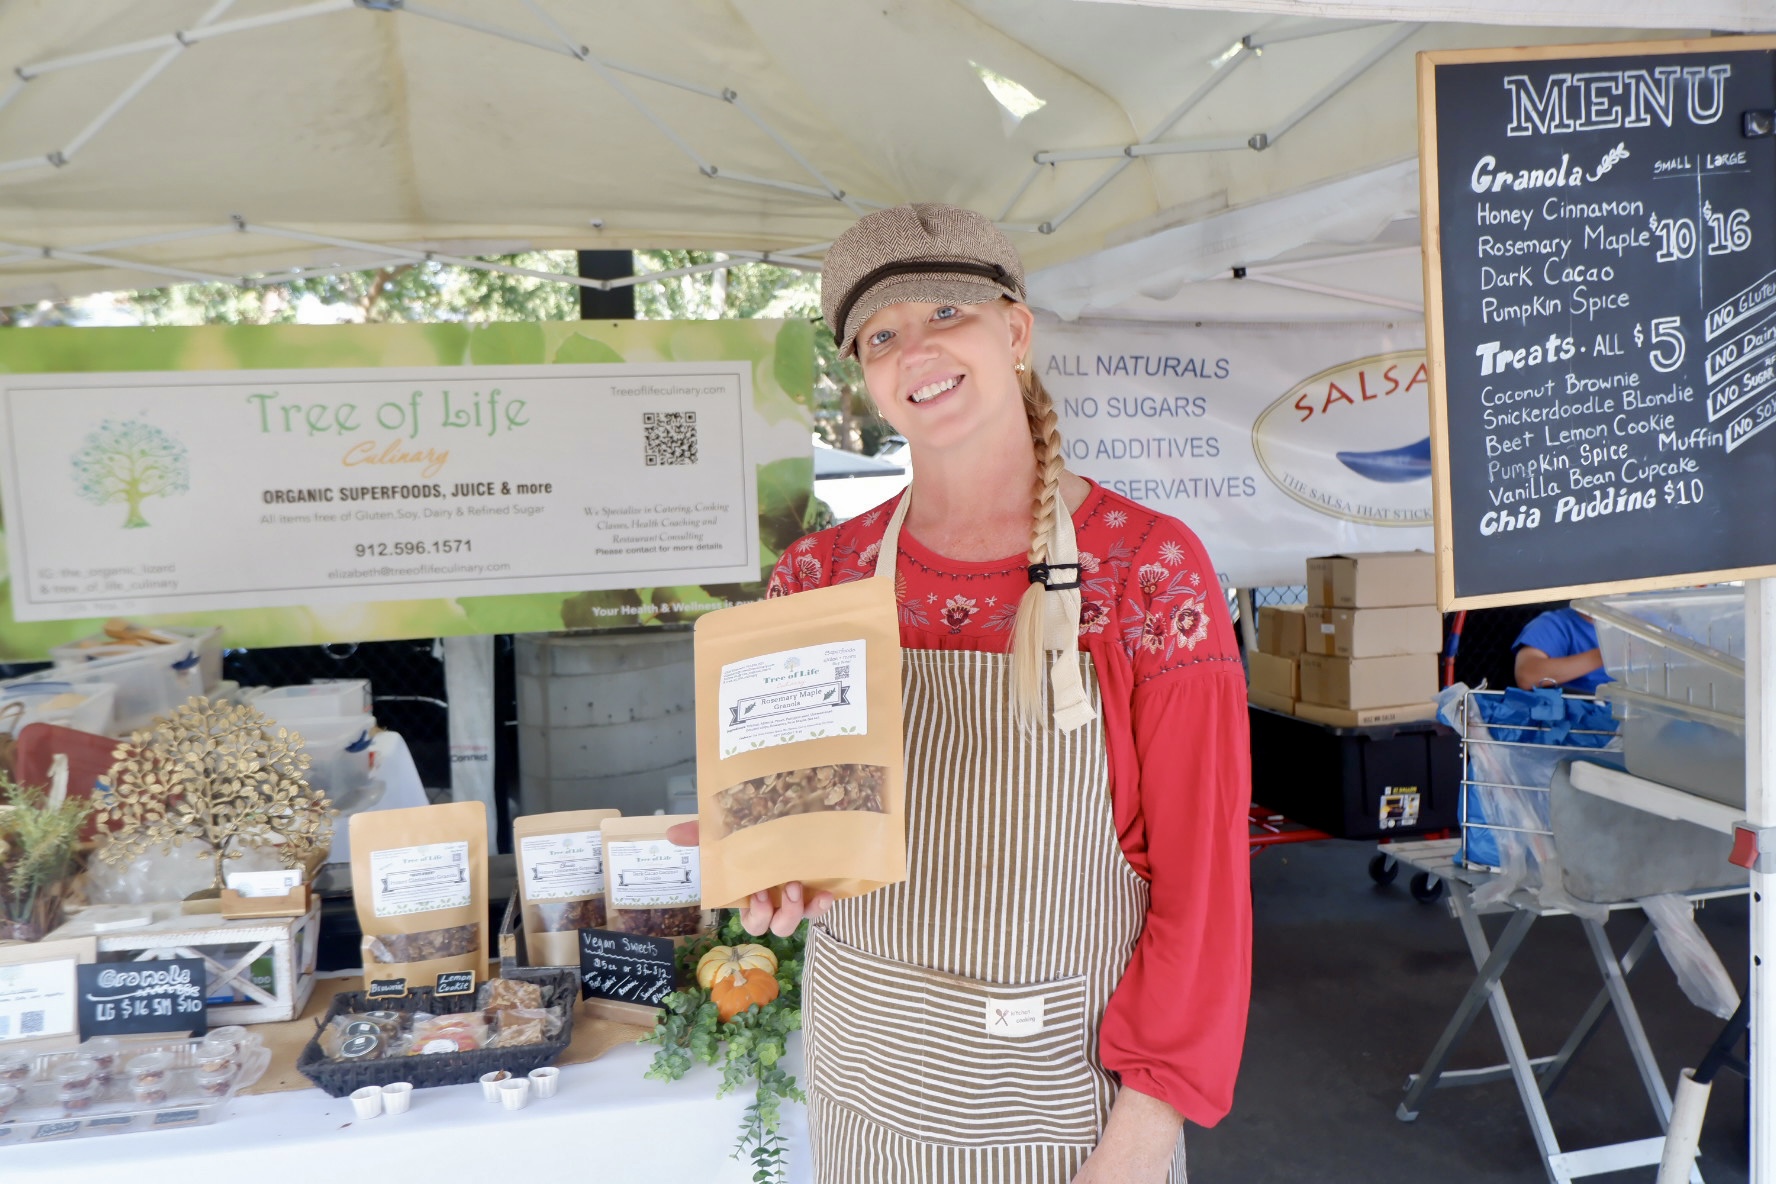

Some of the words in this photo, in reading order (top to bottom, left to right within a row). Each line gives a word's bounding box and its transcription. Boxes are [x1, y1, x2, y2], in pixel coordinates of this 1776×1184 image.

[1504, 64, 1731, 136] MENU
[1471, 154, 1582, 193] Granola
[1653, 154, 1692, 174] SMALL
[1477, 201, 1533, 230] Honey
[1542, 197, 1644, 221] Cinnamon
[1649, 212, 1696, 263] $10
[1703, 199, 1752, 255] $16
[1478, 234, 1571, 259] Rosemary
[1584, 225, 1650, 257] Maple
[1481, 266, 1533, 290] Dark
[1543, 257, 1614, 284] Cacao
[1482, 296, 1561, 325] Pumpkin
[1570, 285, 1630, 321] Spice
[1712, 305, 1734, 331] NO
[1593, 334, 1625, 357] ALL
[1046, 355, 1088, 376] ALL
[1096, 355, 1230, 379] NATURALS
[1714, 345, 1737, 371] NO
[610, 385, 726, 398] Treeoflifeculinary.com
[1481, 379, 1555, 407] Coconut
[1565, 372, 1641, 396] Brownie
[1716, 385, 1739, 410] NO
[246, 390, 361, 437] Tree
[376, 390, 424, 439] of
[441, 388, 531, 437] Life
[1064, 397, 1099, 418] NO
[1107, 396, 1207, 419] SUGARS
[1484, 398, 1614, 430] Snickerdoodle
[1623, 384, 1694, 411] Blondie
[1485, 431, 1534, 457] Beet
[1546, 423, 1607, 447] Lemon
[1613, 412, 1675, 436] Cookie
[1733, 417, 1753, 439] NO
[342, 437, 450, 479] Culinary
[1096, 437, 1220, 460] ADDITIVES
[1488, 450, 1569, 482] Pumpkin
[1580, 441, 1629, 469] Spice
[1658, 427, 1724, 453] Muffin
[263, 488, 334, 504] ORGANIC
[339, 484, 447, 501] SUPERFOODS,
[451, 482, 496, 498] JUICE
[500, 481, 512, 496] &
[517, 482, 552, 495] more
[1489, 479, 1561, 507] Vanilla
[1570, 467, 1615, 491] Bean
[1621, 456, 1699, 484] Cupcake
[1282, 471, 1307, 495] THE
[1309, 488, 1352, 514] SALSA
[1355, 503, 1391, 520] THAT
[1480, 505, 1541, 537] Chia
[1555, 486, 1657, 523] Pudding
[1664, 477, 1704, 506] $10
[280, 512, 311, 524] items
[315, 511, 338, 523] free
[341, 510, 352, 522] of
[423, 507, 452, 520] Dairy
[455, 506, 465, 517] &
[467, 504, 511, 517] Refined
[513, 504, 546, 518] Sugar
[584, 506, 600, 516] We
[631, 519, 659, 530] Health
[355, 540, 472, 558] 912.596.1571
[595, 547, 624, 556] Please
[626, 546, 657, 554] contact
[659, 545, 670, 553] for
[696, 543, 723, 551] details
[592, 606, 619, 617] Your
[621, 604, 659, 616] Health
[661, 602, 671, 613] &
[672, 600, 722, 612] Wellness
[763, 676, 786, 684] Tree
[788, 671, 799, 680] of
[800, 668, 820, 677] Life
[761, 694, 798, 706] Rosemary
[799, 688, 823, 698] Maple
[773, 701, 801, 710] Granola
[583, 932, 616, 953] Vegan
[622, 937, 659, 957] Sweets
[97, 965, 192, 989] Granola
[371, 981, 404, 993] Brownie
[438, 982, 469, 992] Cookie
[440, 974, 473, 984] Lemon
[96, 1003, 116, 1021] LG
[153, 998, 172, 1016] SM
[1010, 1009, 1031, 1017] kitchen
[1015, 1016, 1036, 1024] cooking
